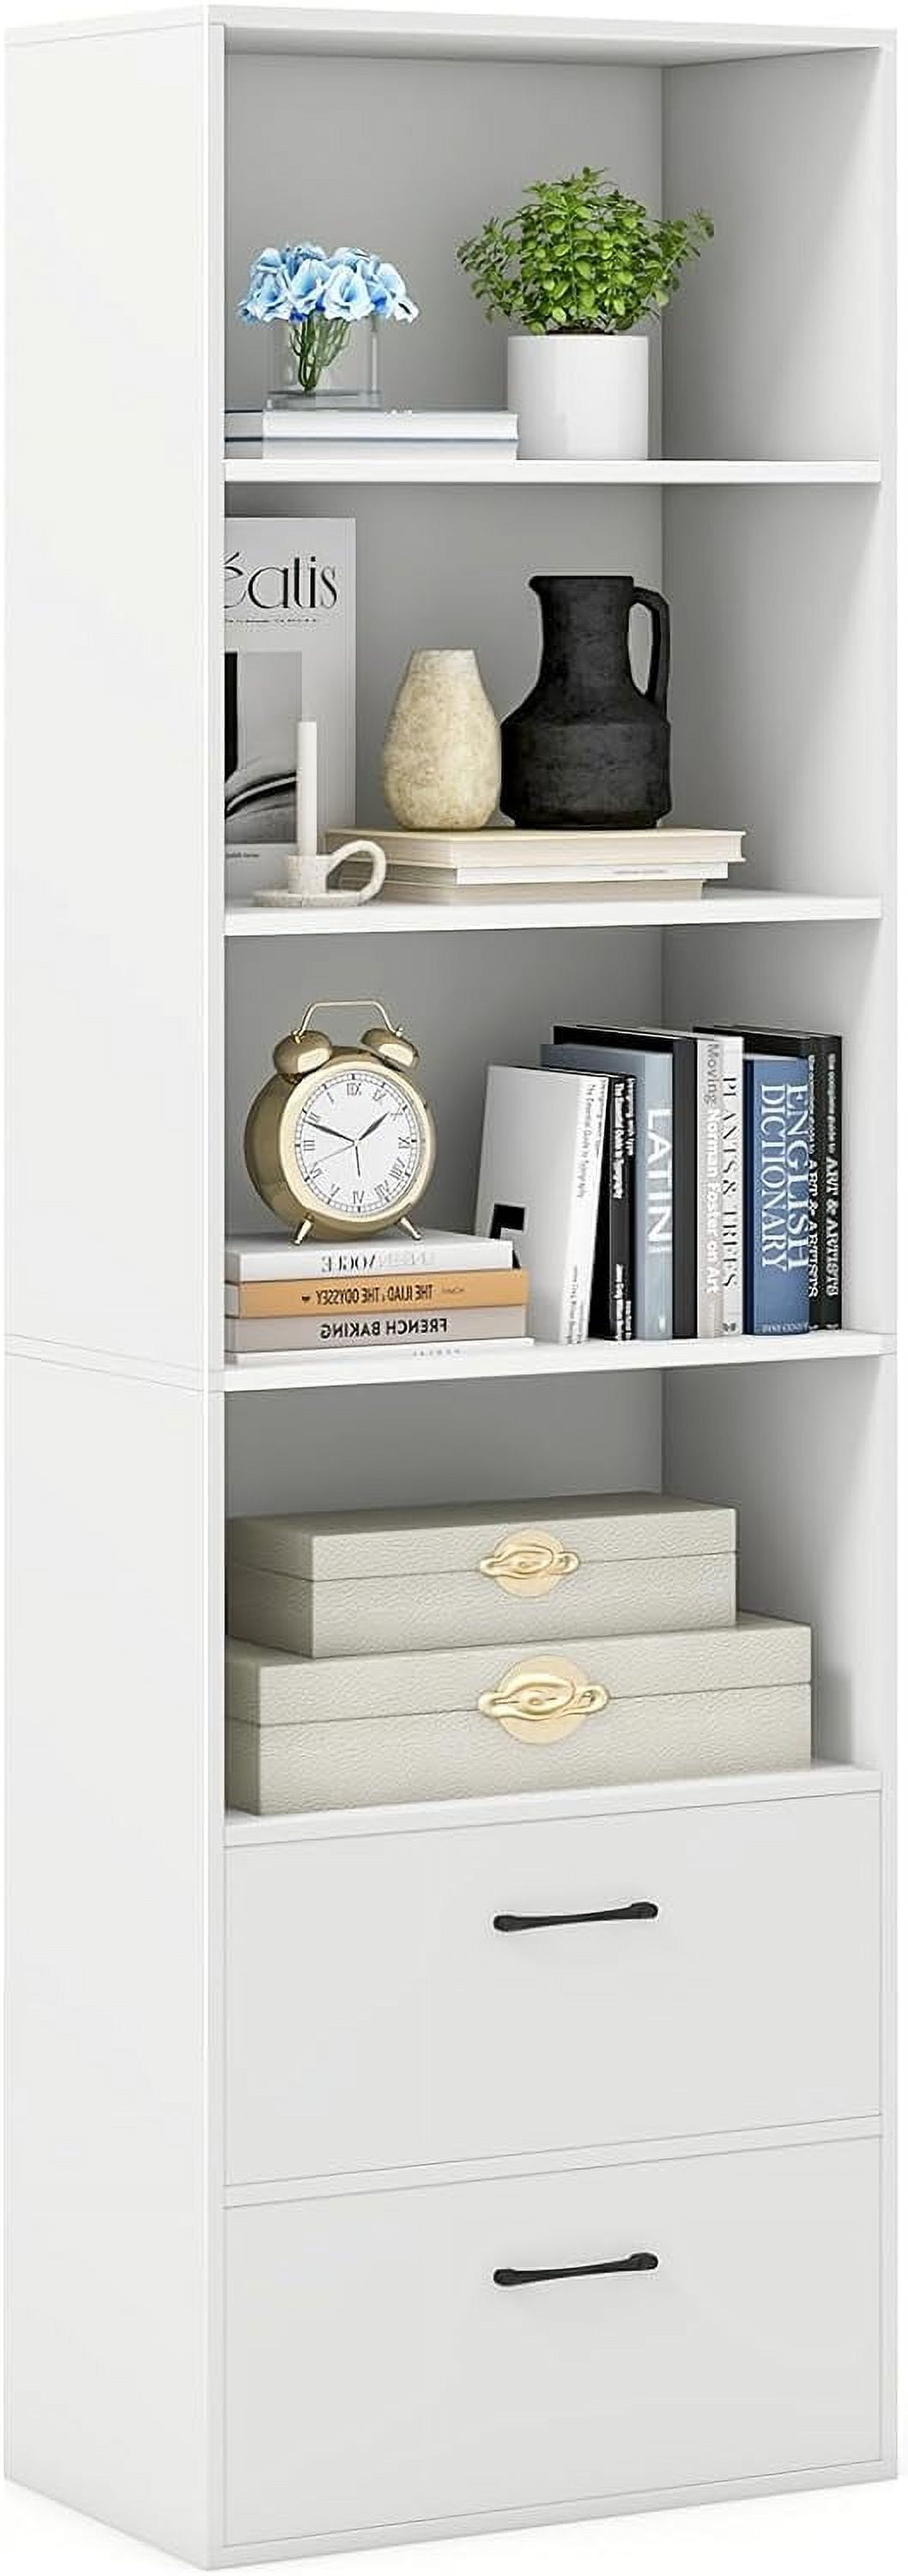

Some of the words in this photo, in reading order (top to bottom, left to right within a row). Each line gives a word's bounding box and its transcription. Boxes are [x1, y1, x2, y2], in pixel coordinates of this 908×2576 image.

[706, 1109, 721, 1176] Norman
[722, 1077, 737, 1174] PLANTS
[760, 1084, 787, 1273] DICTIONARY
[786, 1084, 808, 1271] ENGLISH
[826, 1157, 838, 1195] ART
[826, 1199, 838, 1216] &
[706, 1182, 720, 1238] Foster
[706, 1240, 719, 1263] on
[722, 1205, 737, 1287] TREES
[826, 1219, 838, 1297] ARTISTS
[705, 1267, 720, 1293] Art
